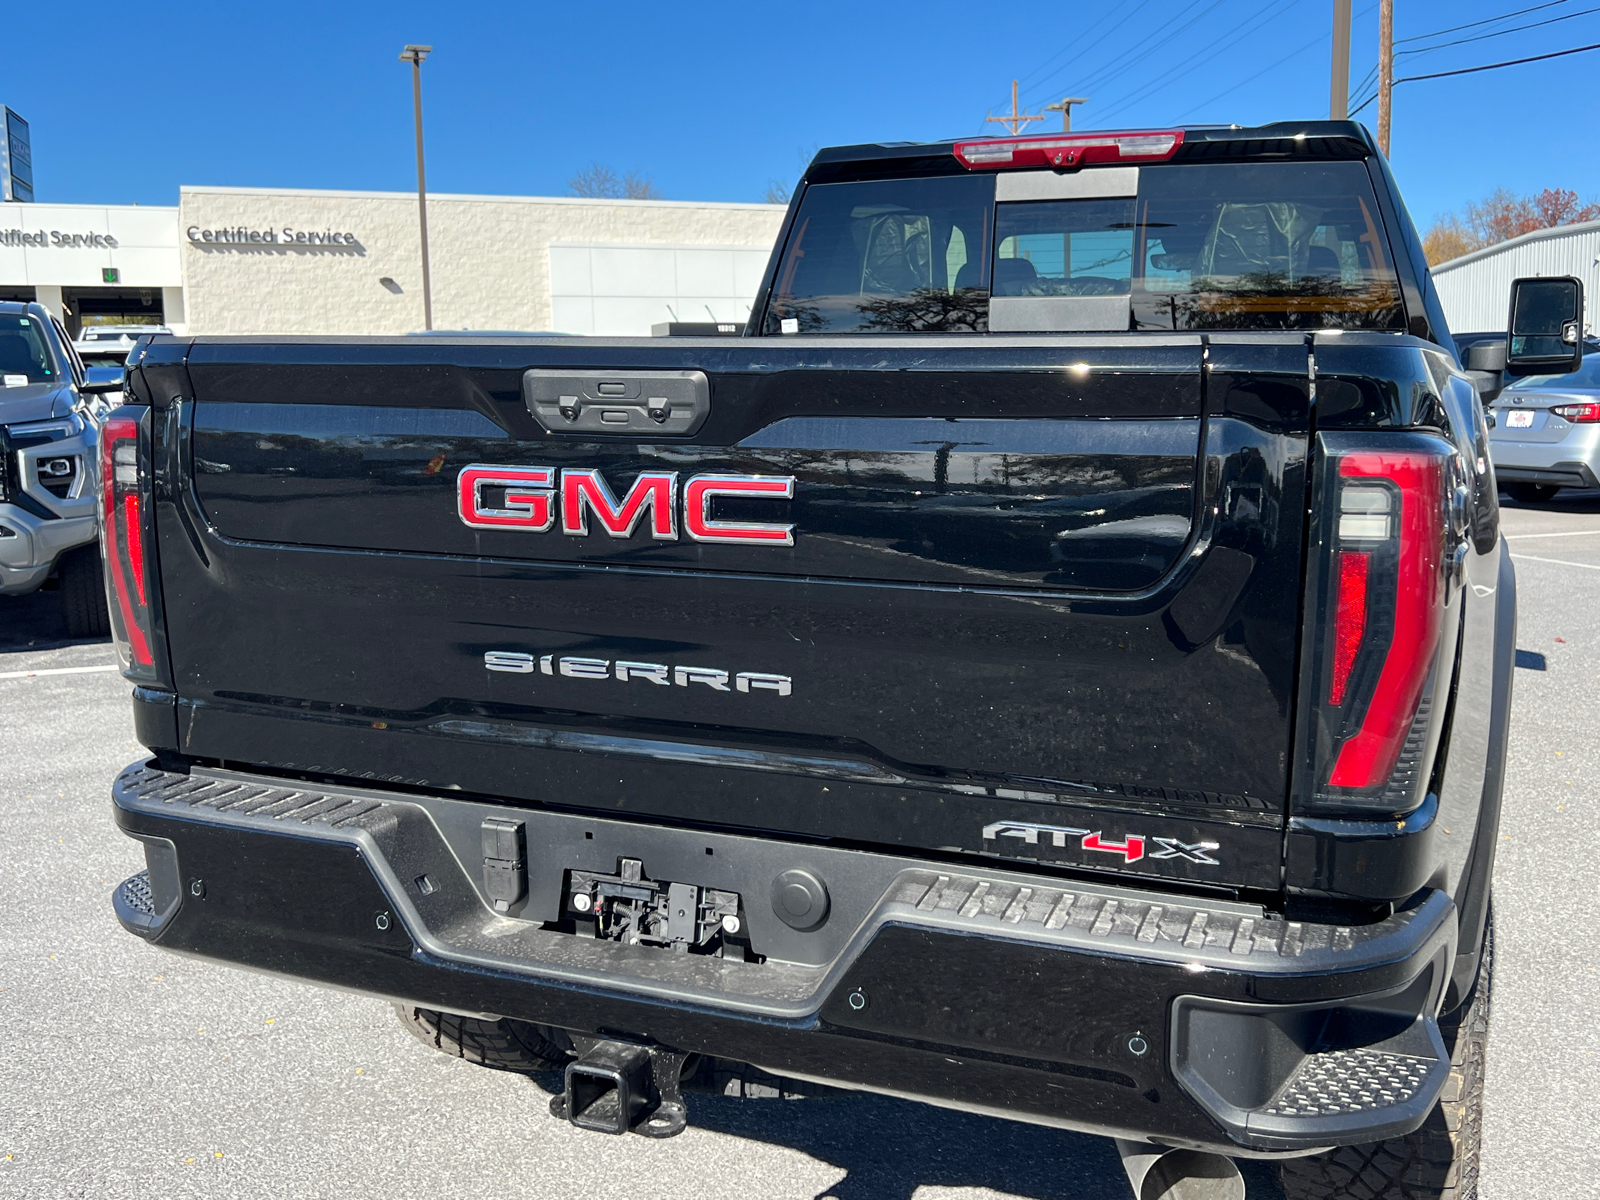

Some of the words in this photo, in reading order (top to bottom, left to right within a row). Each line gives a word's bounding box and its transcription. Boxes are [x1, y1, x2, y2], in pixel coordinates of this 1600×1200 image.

[50, 231, 114, 245] Service
[187, 226, 274, 243] Certified
[282, 228, 354, 244] Service
[457, 463, 796, 546] GMC
[484, 651, 792, 696] SIERRA
[982, 820, 1220, 865] AT4X
